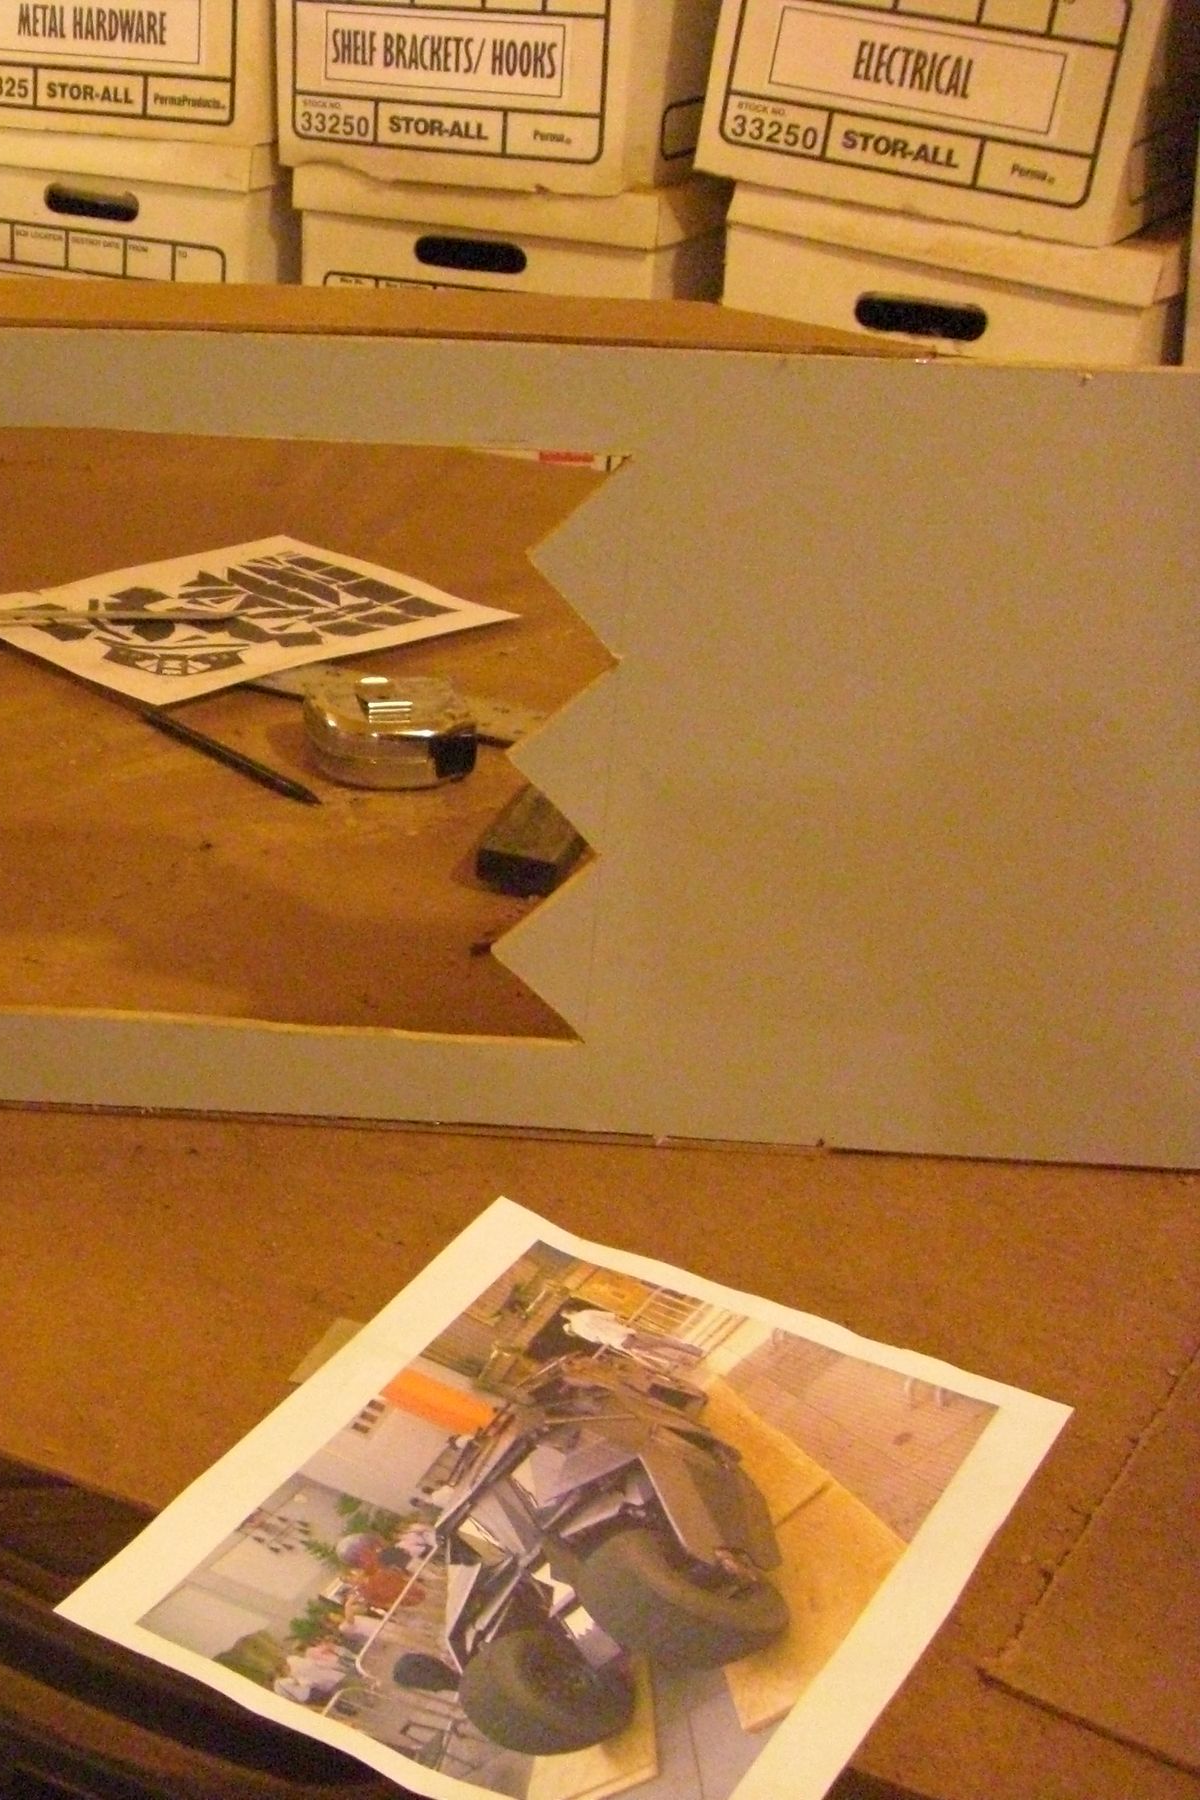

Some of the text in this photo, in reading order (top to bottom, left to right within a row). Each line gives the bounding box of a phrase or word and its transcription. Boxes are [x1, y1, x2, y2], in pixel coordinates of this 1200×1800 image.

[18, 3, 167, 46] METAL HARDWARE
[332, 28, 376, 67] SHELF
[491, 40, 558, 80] HOOKS
[852, 39, 974, 100] ELECTRICAL
[46, 82, 134, 104] STOR-ALL
[300, 111, 369, 138] 33250
[389, 115, 489, 141] STOR-ALL
[730, 114, 818, 151] 33250
[841, 129, 959, 169] STOR-ALL
